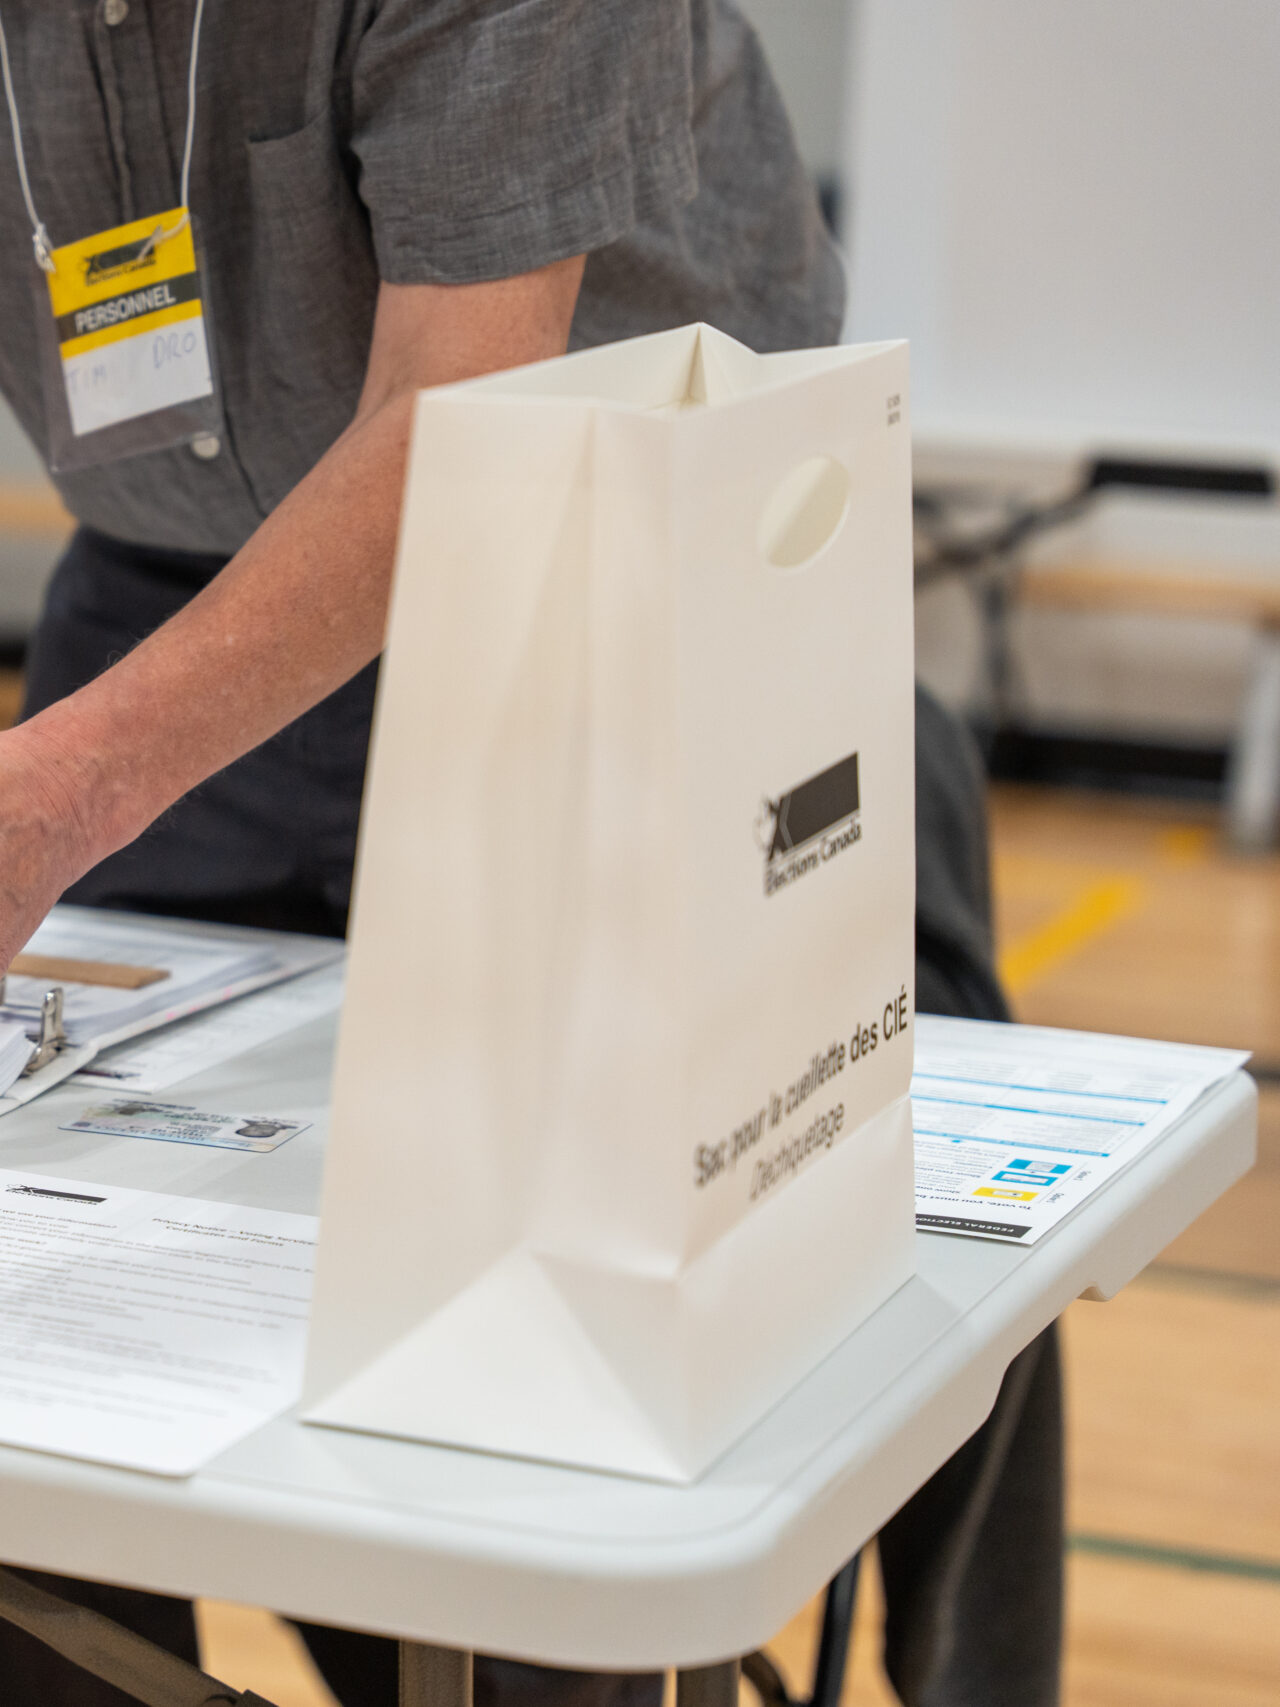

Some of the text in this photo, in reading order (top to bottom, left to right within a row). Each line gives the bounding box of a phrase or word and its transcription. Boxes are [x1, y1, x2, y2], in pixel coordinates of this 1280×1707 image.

[74, 284, 176, 334] PERSONNEL
[153, 330, 198, 370] DRO
[764, 814, 863, 898] Elections Canada
[693, 983, 908, 1189] Sac pour la cueillette des CIÉ
[152, 1217, 188, 1227] Privacy
[192, 1223, 227, 1232] Notice
[964, 1221, 1014, 1233] FEDERAL
